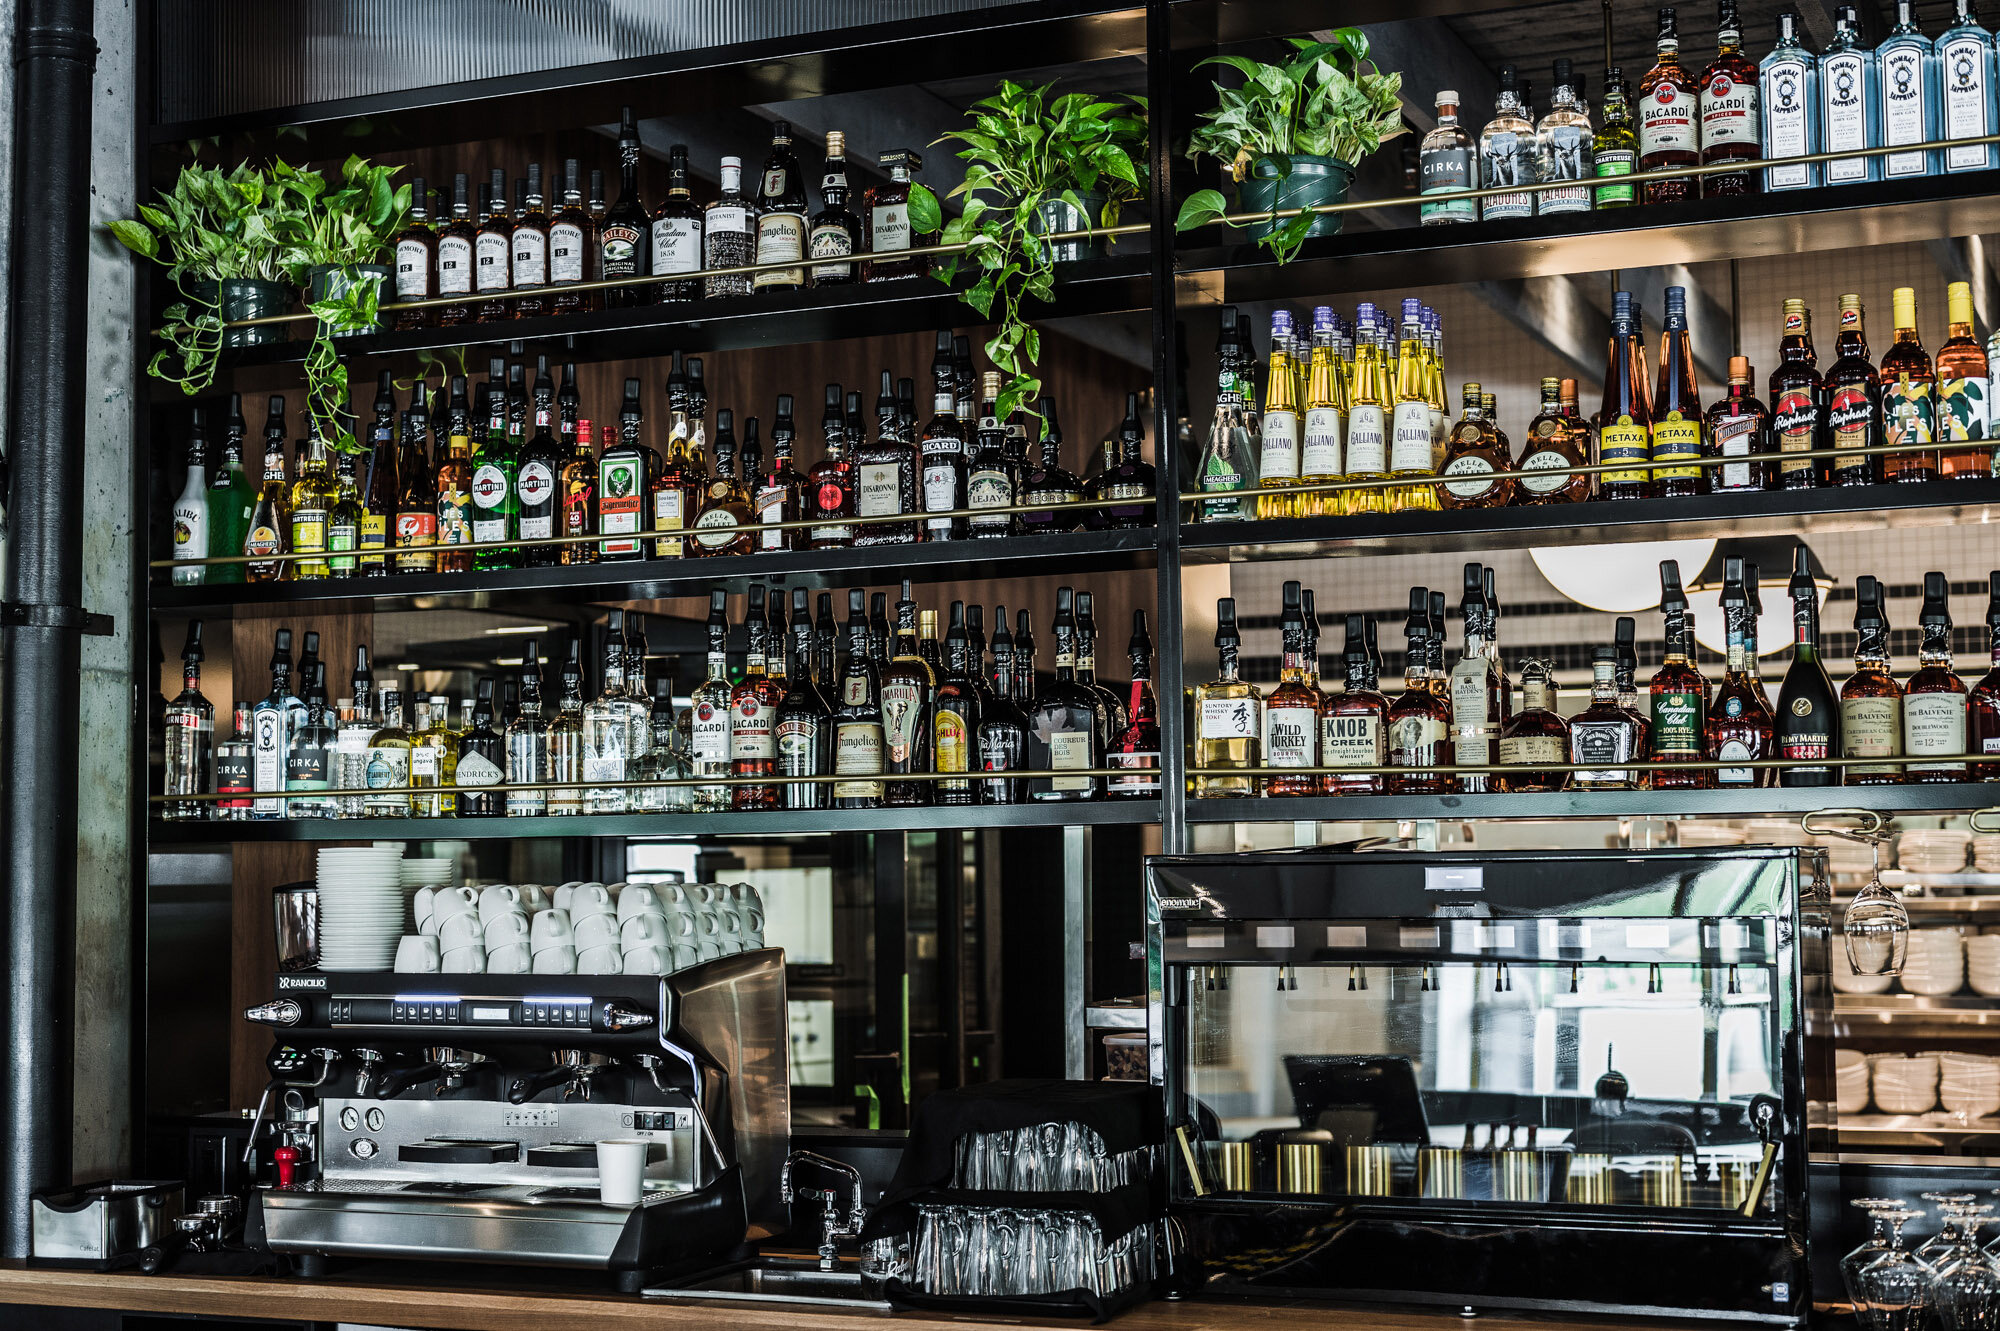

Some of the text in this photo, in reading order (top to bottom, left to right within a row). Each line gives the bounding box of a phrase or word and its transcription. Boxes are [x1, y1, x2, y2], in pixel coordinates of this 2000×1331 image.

[1950, 47, 1977, 60] BOMBAY
[1889, 54, 1915, 67] BOMBAY
[1831, 61, 1857, 73] BOMBAY
[1773, 68, 1799, 82] BOMBAY
[1950, 81, 1979, 93] SAPPHIRE
[1830, 95, 1859, 107] SAPPHIRE
[1889, 90, 1918, 101] SAPPHIRE
[1703, 96, 1745, 114] BACARDÍ
[1772, 102, 1801, 114] SAPPHIRE
[1645, 104, 1688, 120] BACARDÍ
[1595, 155, 1632, 164] CHARTREUSE
[1423, 161, 1464, 175] CIRKA
[709, 213, 736, 221] BOTANIST
[654, 227, 687, 239] Canadian
[758, 224, 797, 240] Frangelico
[875, 223, 908, 234] DISARONNO
[513, 233, 543, 243] OWMORE
[551, 229, 581, 241] OWMORE
[439, 242, 469, 252] OWMORE
[476, 238, 506, 248] OWMORE
[658, 239, 676, 249] Club
[660, 250, 675, 258] 1858
[814, 248, 842, 257] LEJAY
[1396, 428, 1429, 442] GALLIANO
[1656, 429, 1695, 439] METAXA
[1716, 420, 1755, 443] COINTREAU
[1304, 434, 1335, 448] GALLIANO
[1350, 431, 1382, 446] GALLIANO
[1605, 433, 1644, 443] METAXA
[922, 442, 957, 453] RICARD
[1262, 437, 1292, 451] GALLIANO
[1454, 460, 1484, 470] BELLE
[1530, 454, 1560, 465] BELLE
[474, 483, 503, 492] MARTINI
[520, 480, 549, 489] MARTINI
[863, 484, 896, 493] DISARONNO
[973, 494, 1003, 503] LEJAY
[704, 513, 730, 522] BELLE
[1656, 701, 1696, 713] Canadian
[1918, 708, 1954, 716] BALVENIE
[733, 717, 770, 728] BACARDÍ
[1664, 713, 1688, 725] Club
[777, 724, 812, 736] BAILEYS
[936, 724, 961, 738] AHLÚA
[1275, 723, 1301, 735] WILD
[1326, 718, 1367, 738] KNOB
[838, 732, 879, 749] Frangelico
[1270, 733, 1306, 748] TURKEY
[1331, 739, 1374, 747] CREEK
[1799, 733, 1829, 742] MARTIN
[1924, 738, 1934, 746] 12
[1330, 747, 1351, 756] straight
[289, 758, 320, 768] CIRKA
[590, 760, 617, 780] Sauza
[1161, 898, 1199, 907] enomatic
[290, 979, 326, 987] RANCILIO
